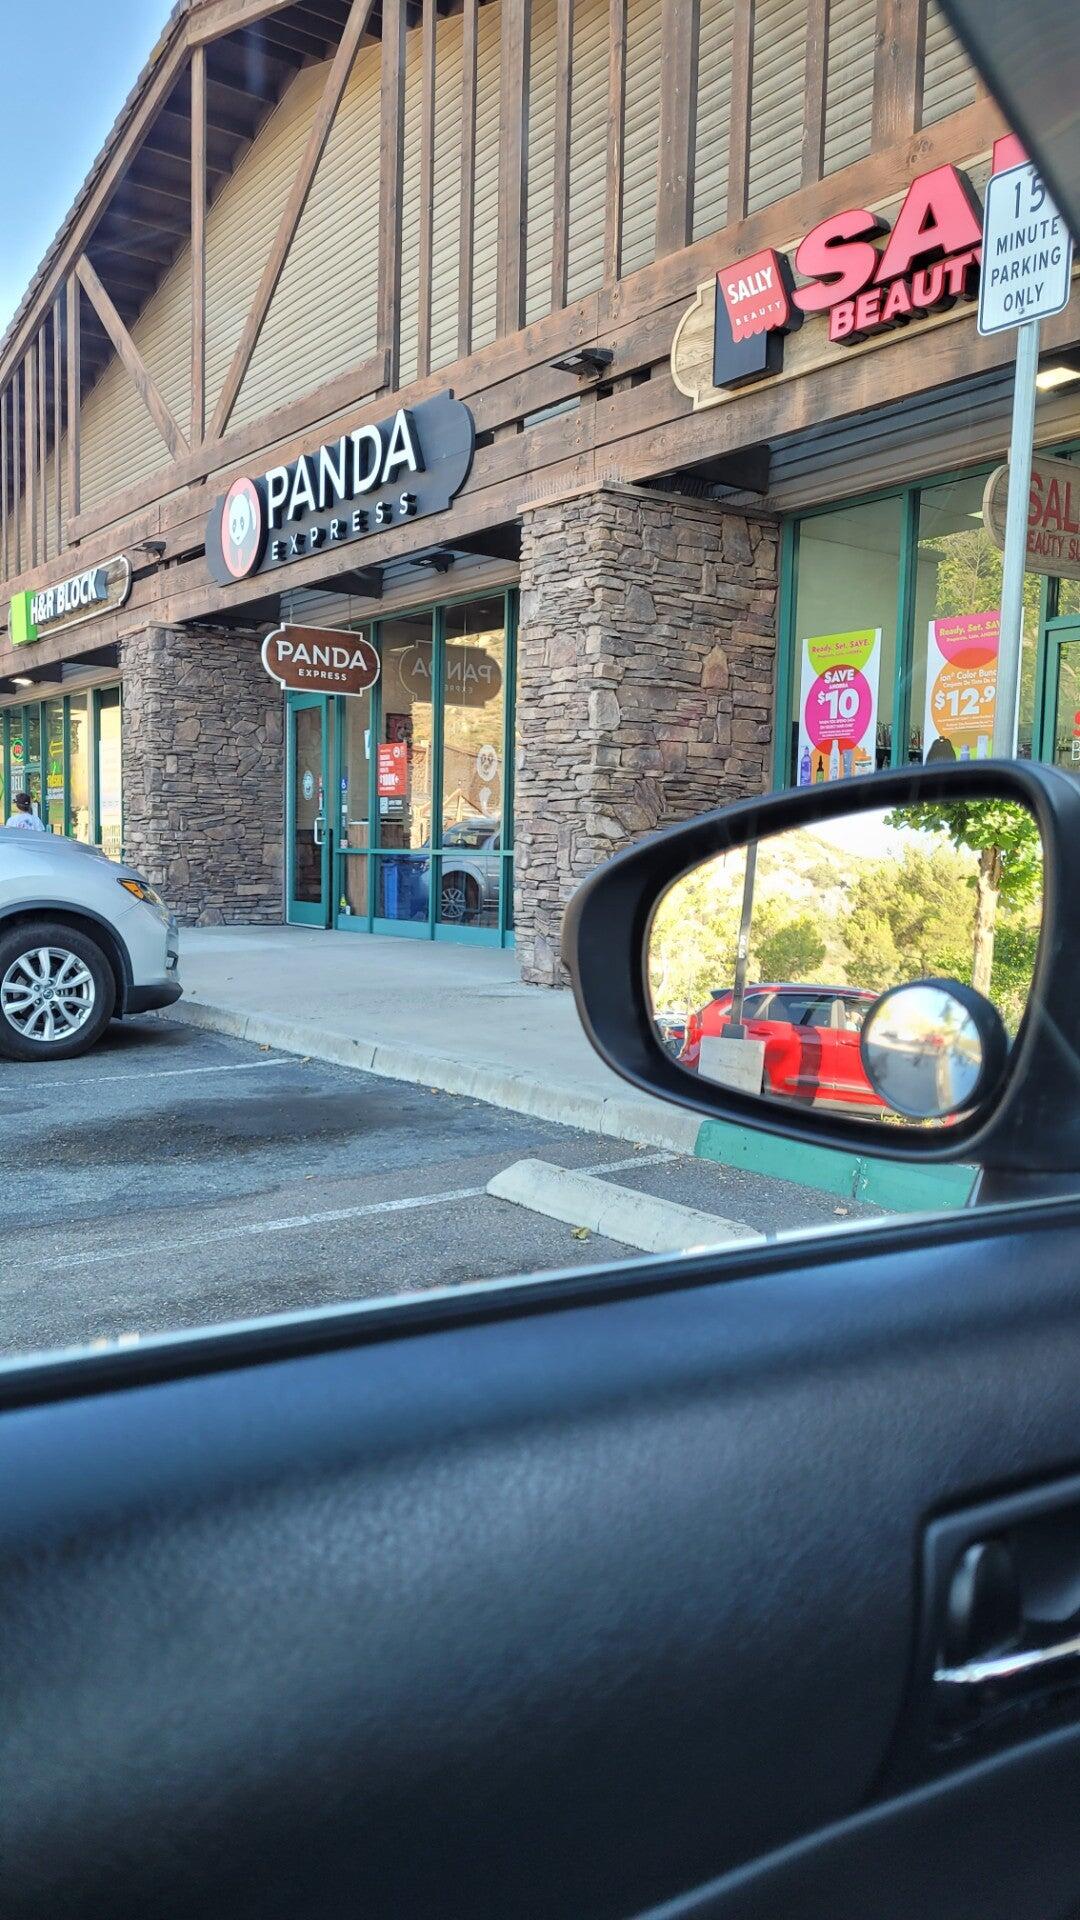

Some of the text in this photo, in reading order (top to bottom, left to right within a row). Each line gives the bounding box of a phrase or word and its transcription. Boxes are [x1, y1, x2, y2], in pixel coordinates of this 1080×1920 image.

[1013, 174, 1046, 219] 15
[791, 133, 1031, 311] SA
[996, 214, 1062, 256] MINUTE
[727, 266, 772, 304] SALLY
[990, 246, 1062, 287] PARKING
[735, 300, 782, 326] BEAUTY
[1003, 282, 1045, 312] ONLY
[265, 408, 417, 529] PANDA
[271, 491, 412, 561] EXPRESS
[1027, 529, 1064, 558] EAUTY
[30, 568, 98, 625] H&R BLOCK
[276, 640, 368, 672] PANDA
[298, 668, 347, 682] EXPRESS
[824, 668, 855, 684] SAVE
[817, 688, 860, 719] $10
